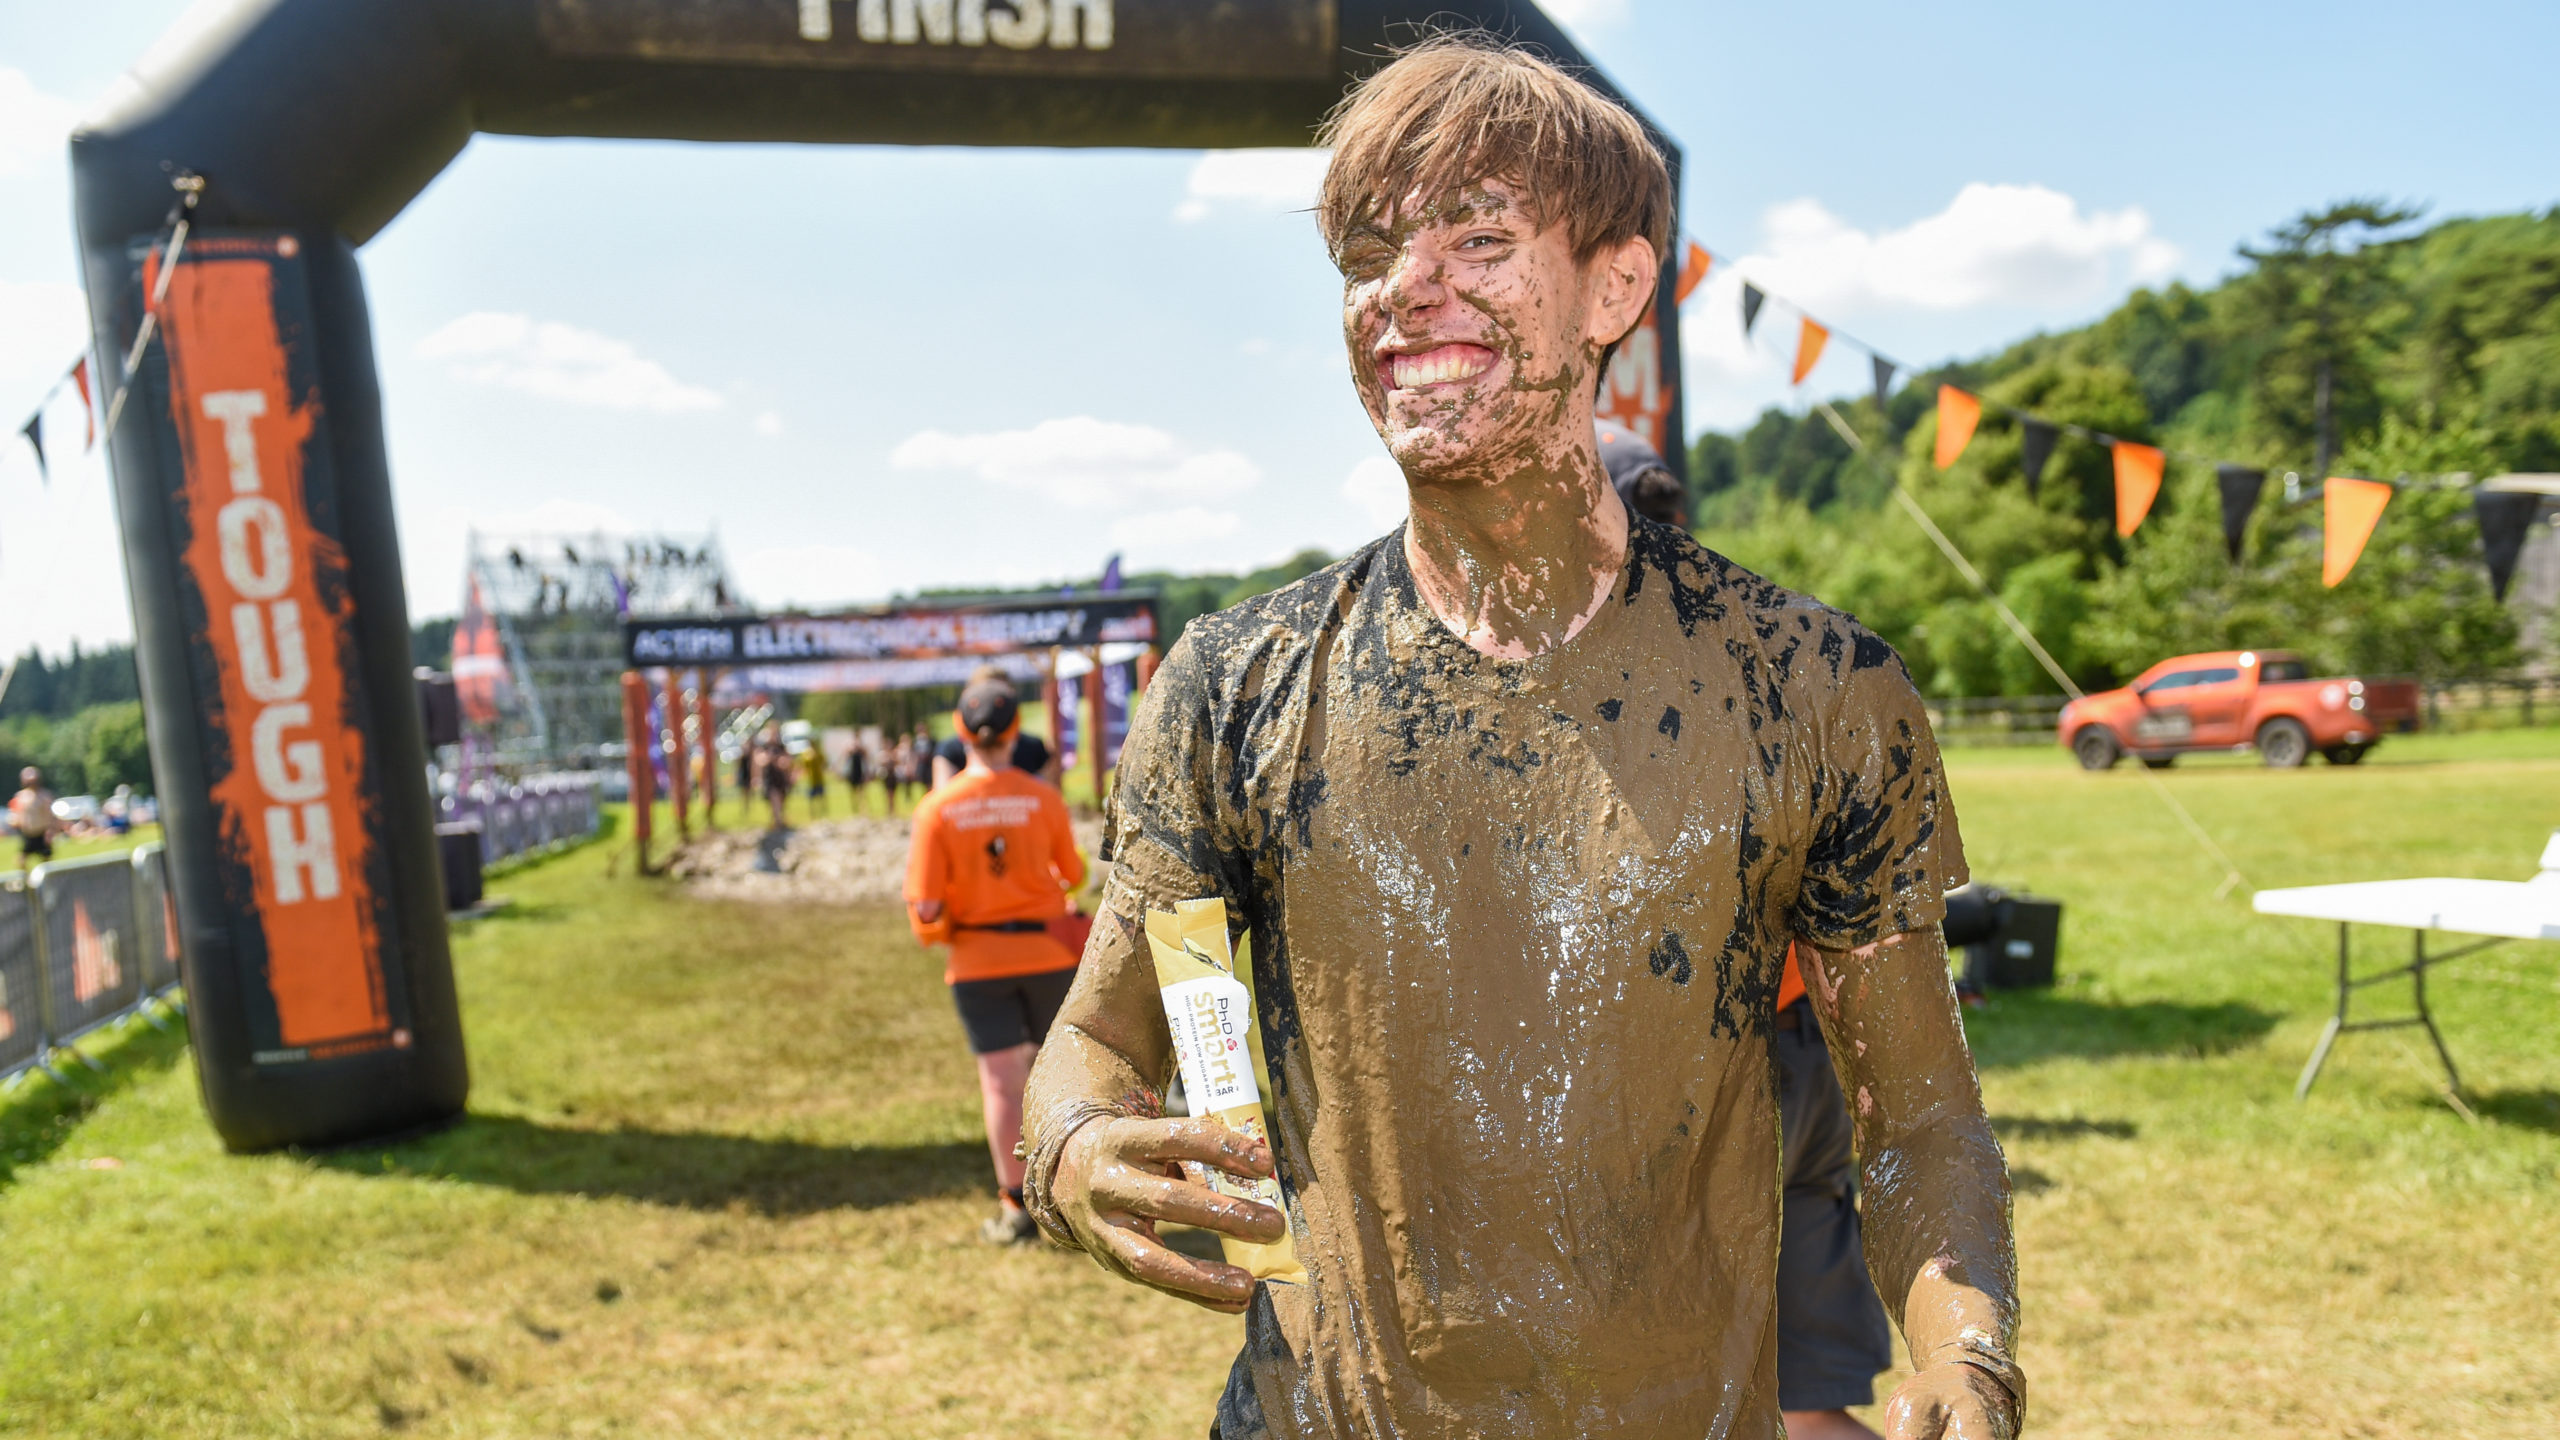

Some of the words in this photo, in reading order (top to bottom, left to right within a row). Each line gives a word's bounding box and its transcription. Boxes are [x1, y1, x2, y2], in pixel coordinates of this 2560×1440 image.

[201, 389, 341, 905] TOUGH
[1189, 1014, 1199, 1042] PROTEIN
[1195, 1043, 1203, 1058] LOW
[1199, 1060, 1209, 1083] SUGAR
[1193, 991, 1236, 1087] smart
[1217, 997, 1233, 1035] PhD
